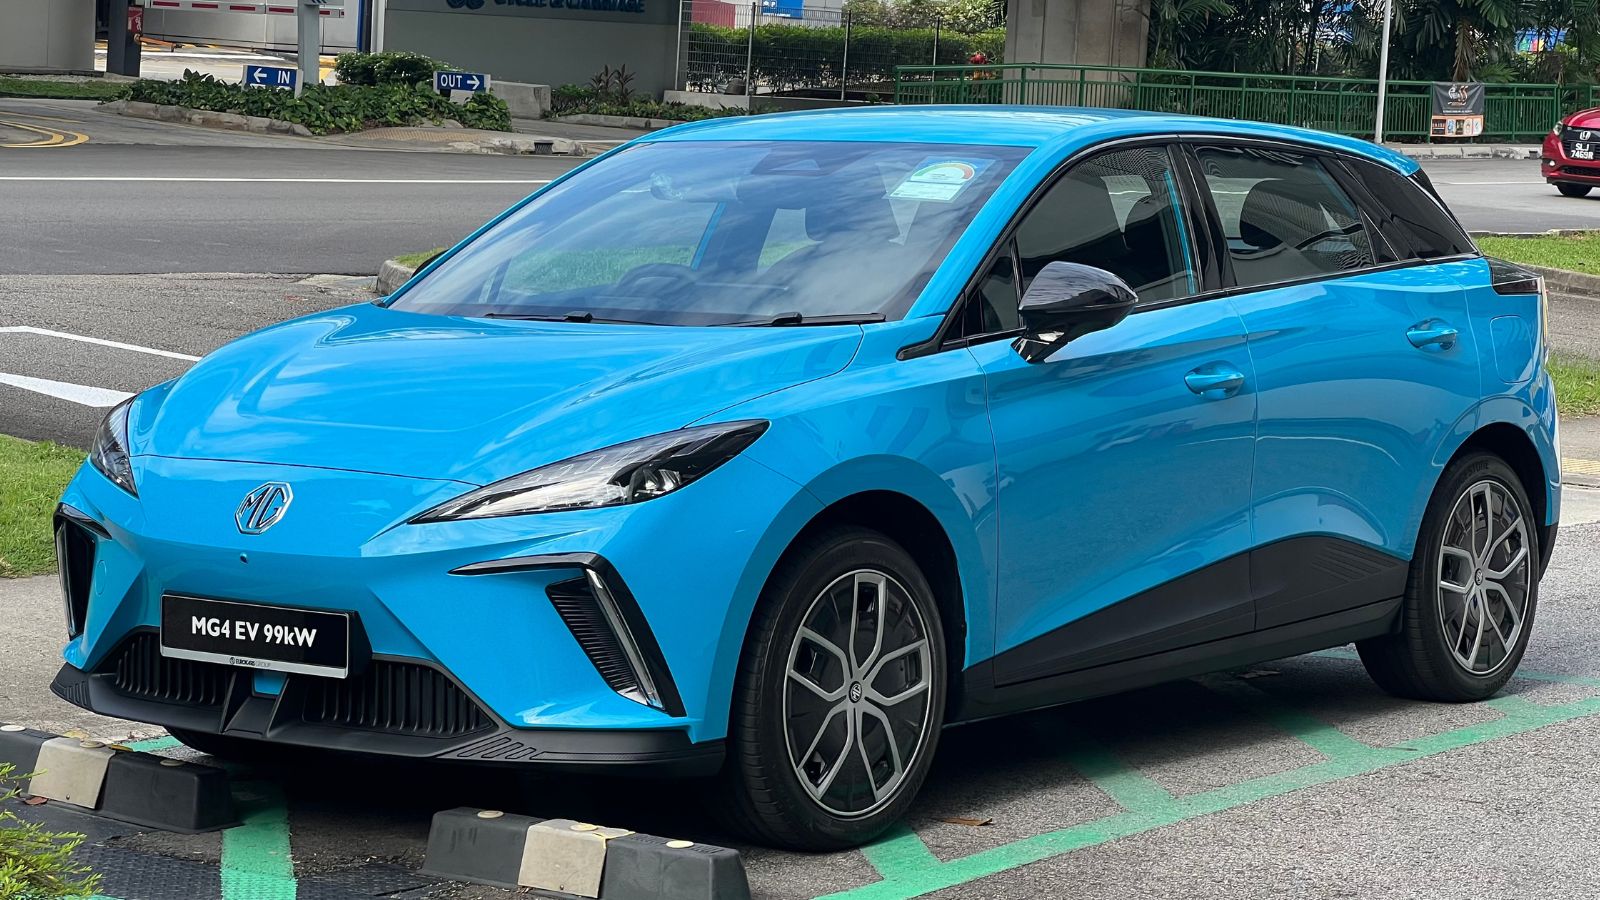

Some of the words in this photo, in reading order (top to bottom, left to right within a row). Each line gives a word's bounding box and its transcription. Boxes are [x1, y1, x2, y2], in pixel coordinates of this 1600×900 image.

[277, 70, 290, 84] IN
[440, 74, 463, 88] OUT
[1575, 142, 1590, 151] SLJ
[237, 484, 290, 531] MG
[191, 615, 230, 638] MG4
[235, 620, 260, 641] EV
[263, 623, 317, 647] 99kW
